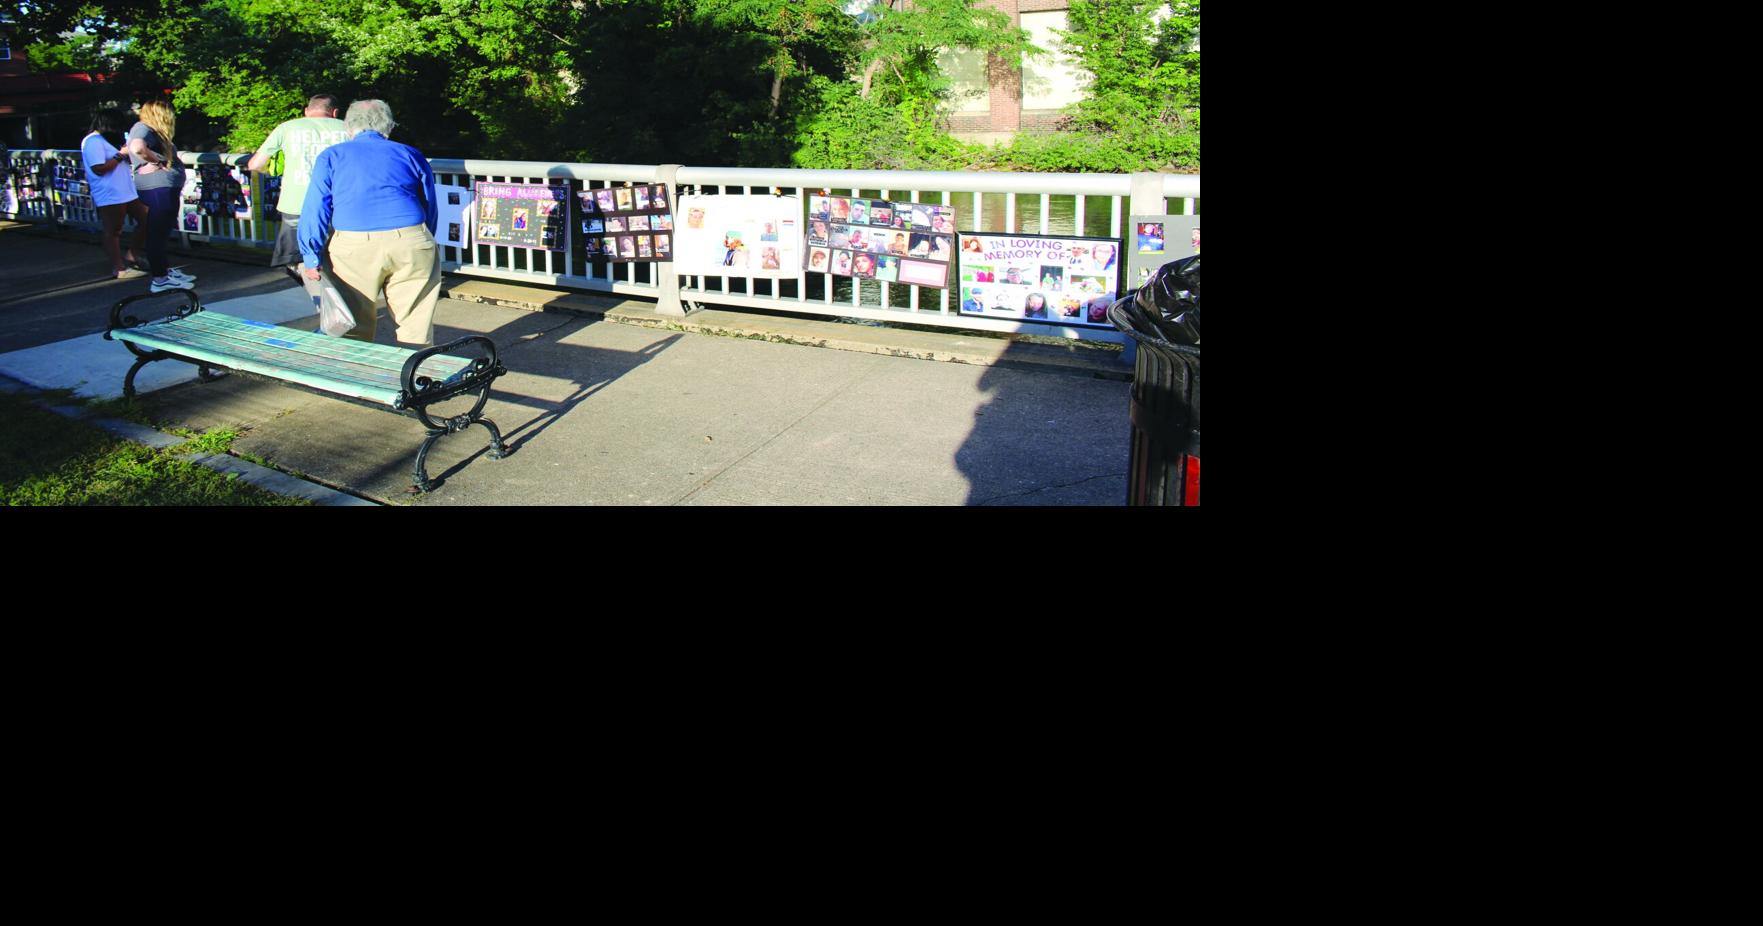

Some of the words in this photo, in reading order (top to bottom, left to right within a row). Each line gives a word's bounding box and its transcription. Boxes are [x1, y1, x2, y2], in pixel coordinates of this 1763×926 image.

[483, 186, 512, 197] BRING
[990, 240, 1005, 250] IN
[1010, 239, 1063, 251] LOVING
[984, 250, 1042, 261] MEMORY
